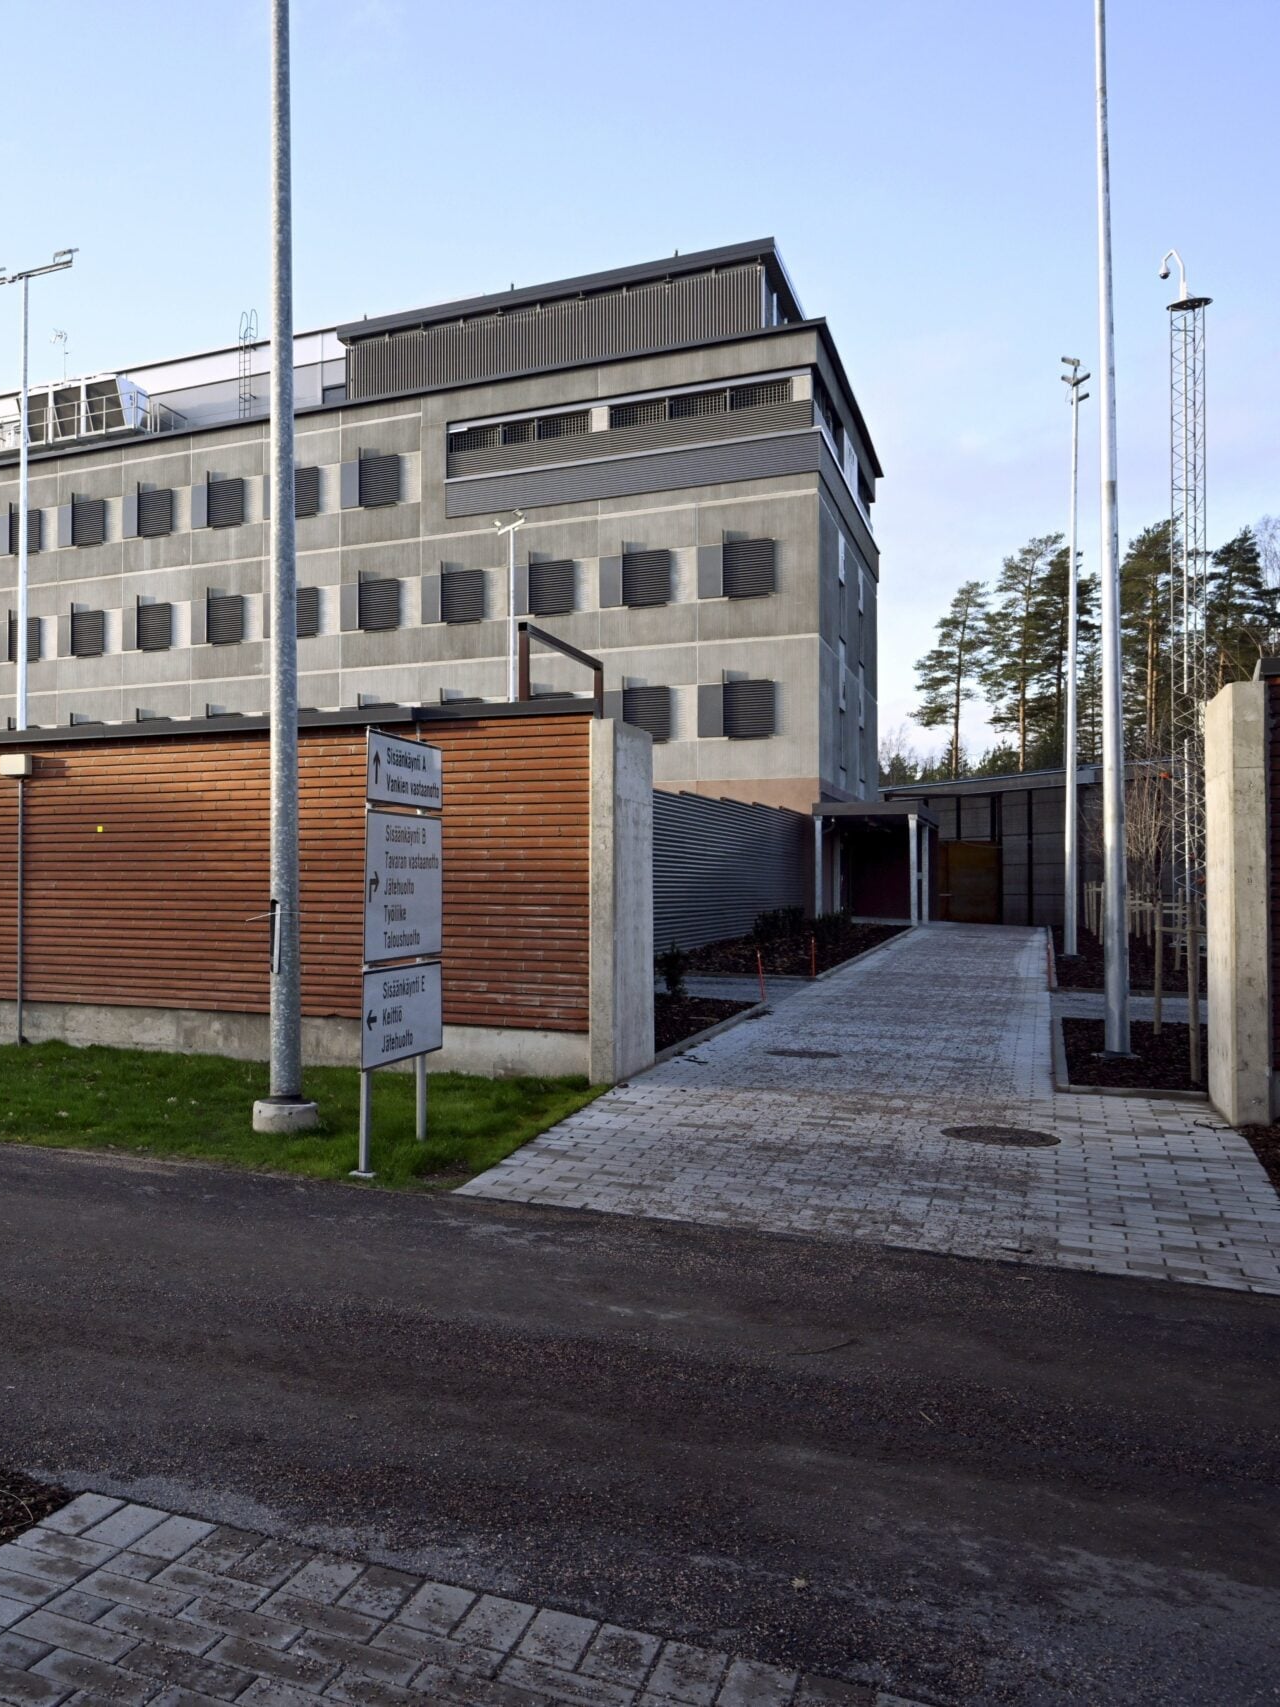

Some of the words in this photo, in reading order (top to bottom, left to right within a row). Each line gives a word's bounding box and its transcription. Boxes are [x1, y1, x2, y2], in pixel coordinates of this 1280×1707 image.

[422, 755, 427, 772] A
[386, 773, 409, 795] Vankien
[410, 781, 440, 799] vastaanotto
[385, 824, 420, 846] Sisäänkäynti
[385, 851, 407, 870] Tavaran
[408, 854, 439, 870] vastaanotto
[384, 878, 415, 896] Jätehuolto
[384, 928, 420, 949] Taloushuolto
[383, 977, 419, 999] Sisäänkäynti
[421, 975, 426, 992] E
[382, 1005, 402, 1026] Keittiö
[381, 1029, 413, 1053] Jätehuolto
